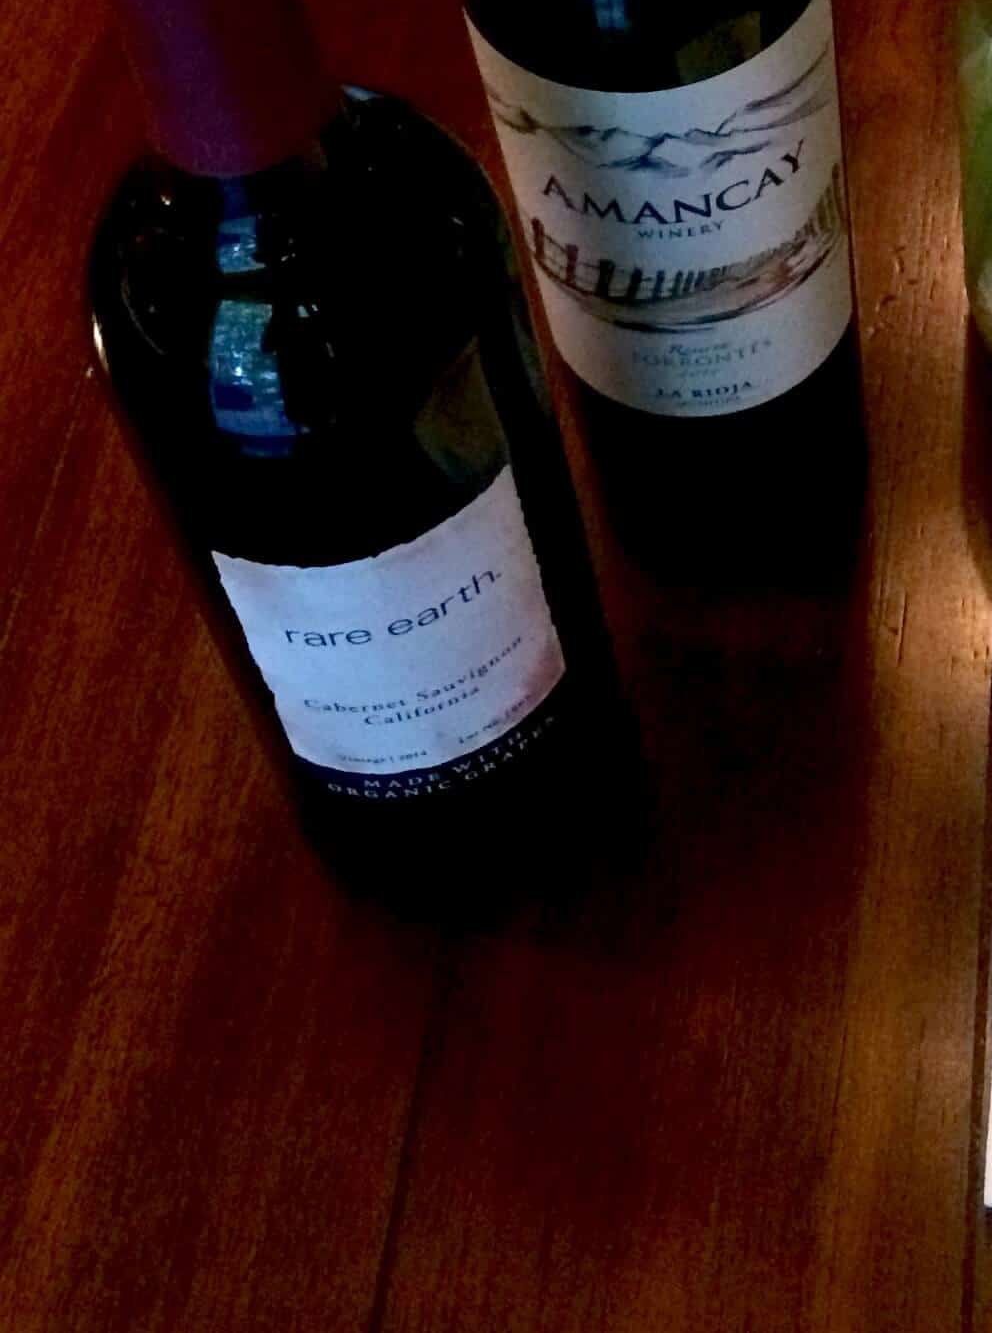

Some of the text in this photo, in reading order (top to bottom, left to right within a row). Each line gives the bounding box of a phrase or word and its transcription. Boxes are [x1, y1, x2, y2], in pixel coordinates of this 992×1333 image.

[542, 138, 804, 225] AMANCAY
[637, 218, 723, 240] WINERY
[285, 628, 373, 648] rare
[303, 636, 523, 714] Cabernet Sauvignon
[364, 686, 481, 727] California
[327, 780, 452, 798] ORGANIC
[364, 773, 441, 788] MADE
